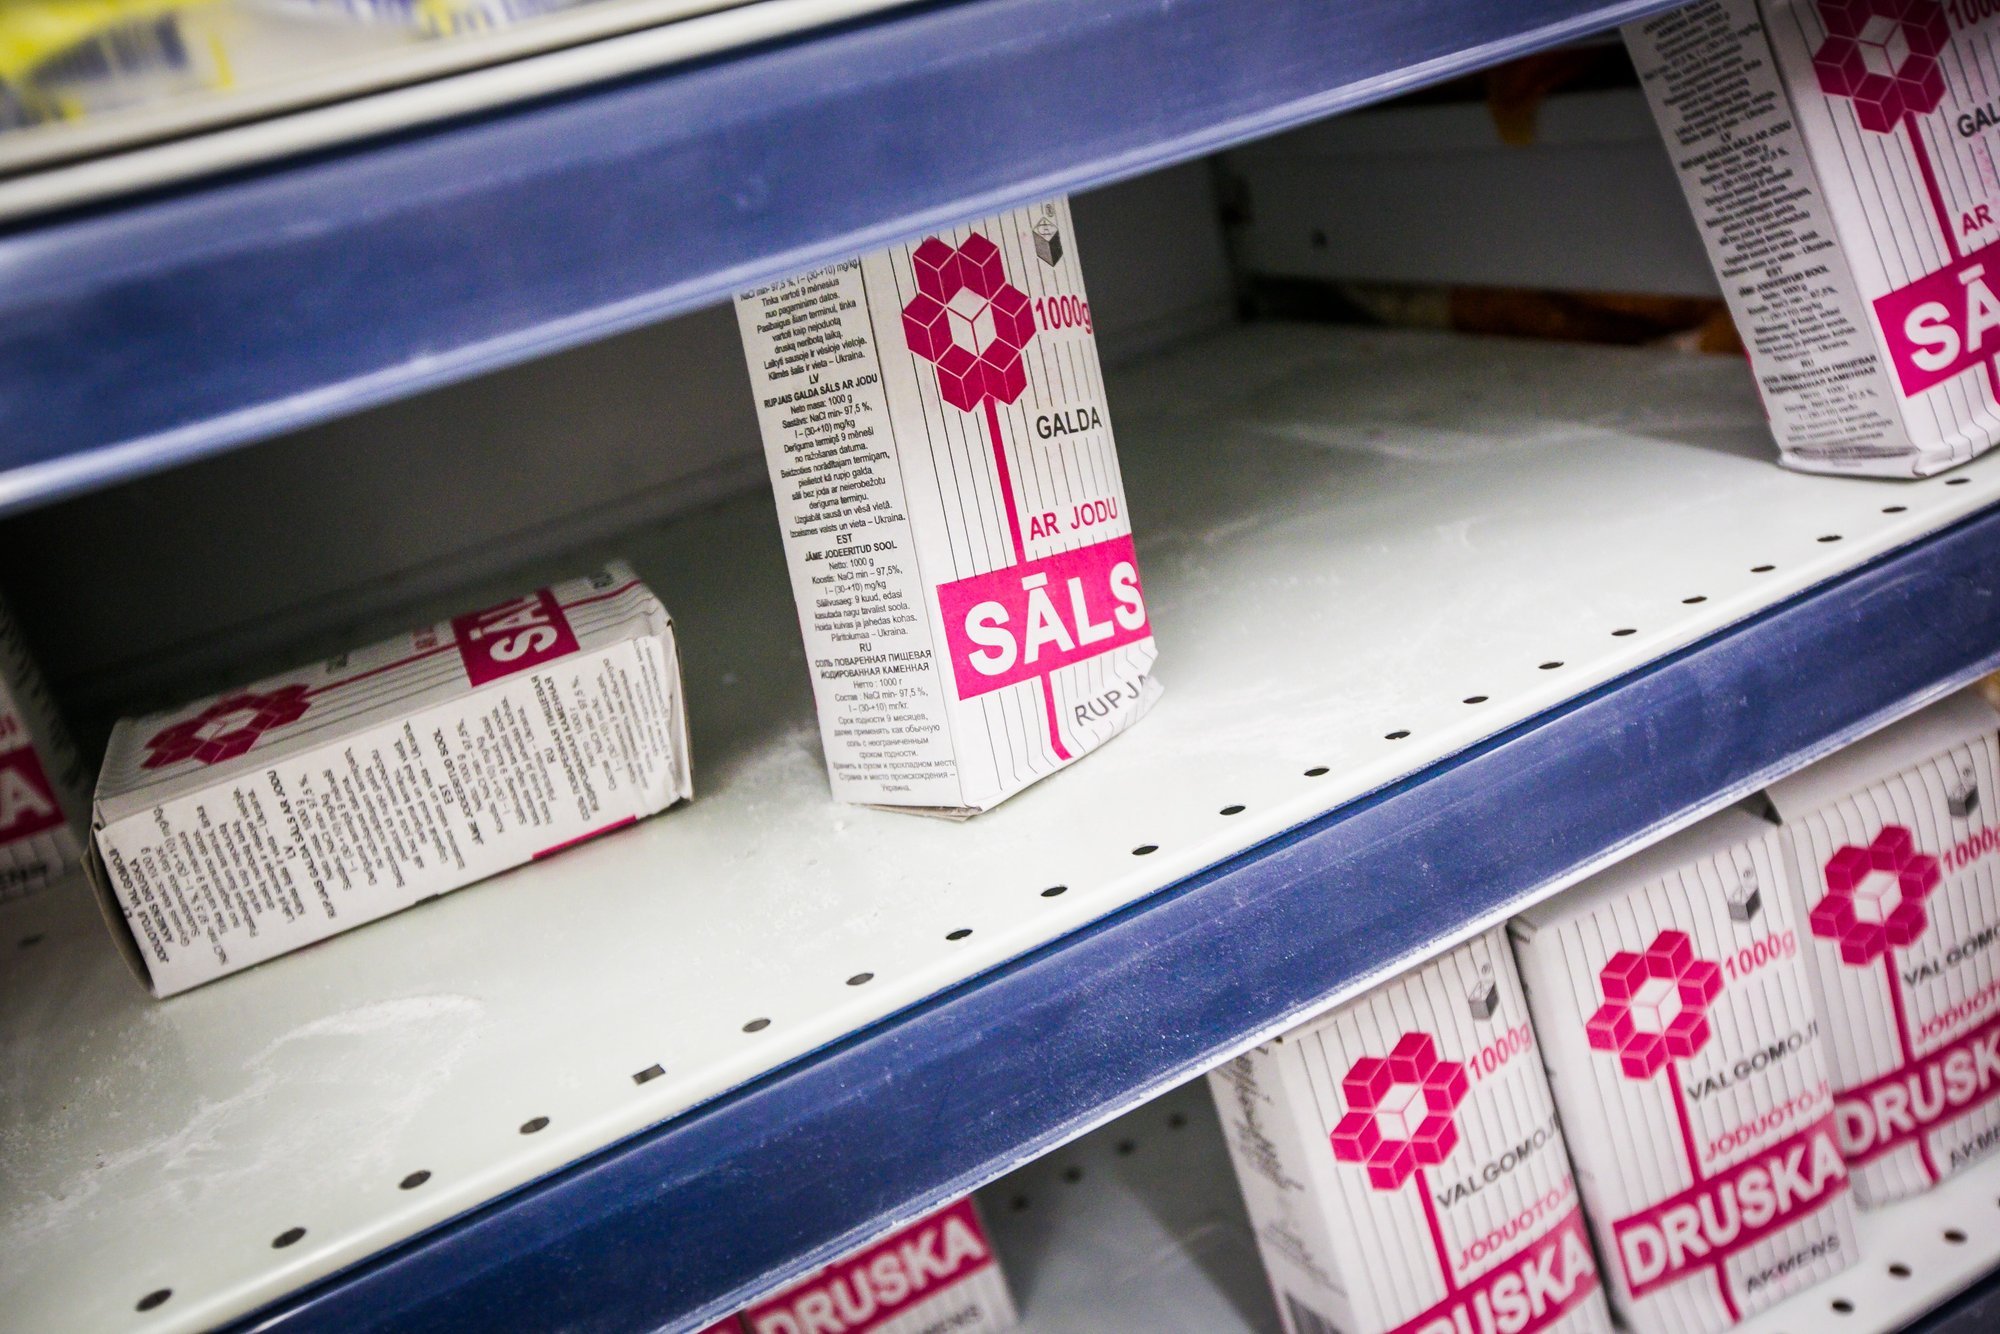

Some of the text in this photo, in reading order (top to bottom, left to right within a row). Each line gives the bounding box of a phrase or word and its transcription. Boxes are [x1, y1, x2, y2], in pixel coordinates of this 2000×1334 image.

[1962, 204, 1995, 236] AR
[1036, 294, 1093, 334] 1000g
[764, 394, 793, 408] RUPJAIS
[794, 388, 819, 401] GALDA
[820, 382, 841, 395] SĀLS
[856, 374, 877, 387] JODU
[829, 394, 846, 405] 1000
[844, 403, 861, 415] 97,5
[834, 419, 856, 431] mg/kg
[1036, 406, 1102, 439] GALDA
[839, 443, 868, 454] datuma.
[834, 472, 850, 481] rupjo
[874, 514, 905, 525] Ukraina.
[1030, 497, 1118, 540] AR JODU
[836, 533, 852, 544] EST
[825, 544, 872, 559] JODEERITUD
[874, 541, 897, 551] SOOL
[851, 557, 867, 567] 1000
[883, 590, 902, 600] edasi
[888, 602, 910, 612] soola.
[892, 615, 917, 623] kohas.
[964, 561, 1146, 676] SĀLS
[877, 628, 908, 637] Ukraina.
[888, 650, 931, 661] ПИЩЕВАЯ
[883, 662, 929, 674] КАМЕННАЯ
[880, 678, 897, 687] 1000
[899, 688, 916, 698] 97,5
[545, 748, 556, 764] RU
[268, 771, 285, 797] JODU
[439, 785, 454, 805] EST
[280, 799, 292, 814] AR
[284, 846, 296, 859] LV
[130, 858, 154, 902] DRUSKA
[1724, 928, 1797, 982] 1000g
[1469, 1022, 1533, 1081] 1000g
[1687, 1018, 1819, 1102] VALGOMOJI
[1705, 1079, 1831, 1162] JODUOTOJI
[1620, 1130, 1848, 1287] DRUSKA
[1745, 1234, 1841, 1294] AKMENS
[755, 1216, 986, 1334] DRUSKA
